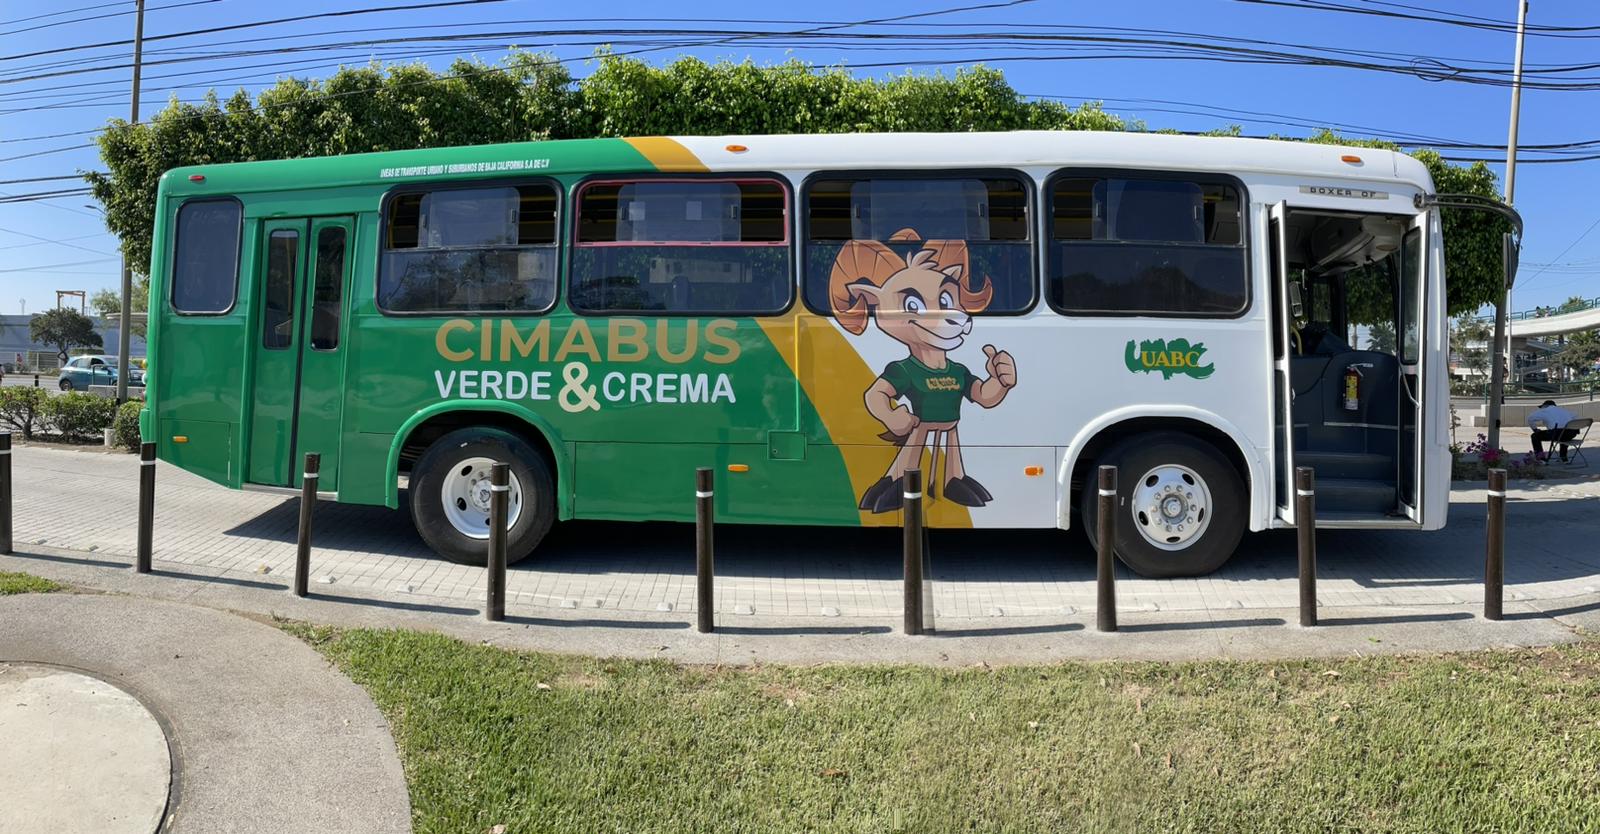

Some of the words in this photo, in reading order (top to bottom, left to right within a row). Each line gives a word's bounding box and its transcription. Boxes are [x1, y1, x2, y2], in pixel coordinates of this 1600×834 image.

[444, 164, 449, 174] Y
[478, 162, 485, 172] DE
[485, 161, 497, 171] BAJA
[497, 160, 524, 171] CALIFORNIA
[533, 159, 541, 168] DE
[1310, 187, 1351, 196] BOXER
[435, 318, 741, 364] CIMABUS
[1141, 351, 1200, 368] UABC
[434, 370, 552, 400] VERDE
[558, 361, 601, 413] &
[602, 372, 736, 403] CREMA
